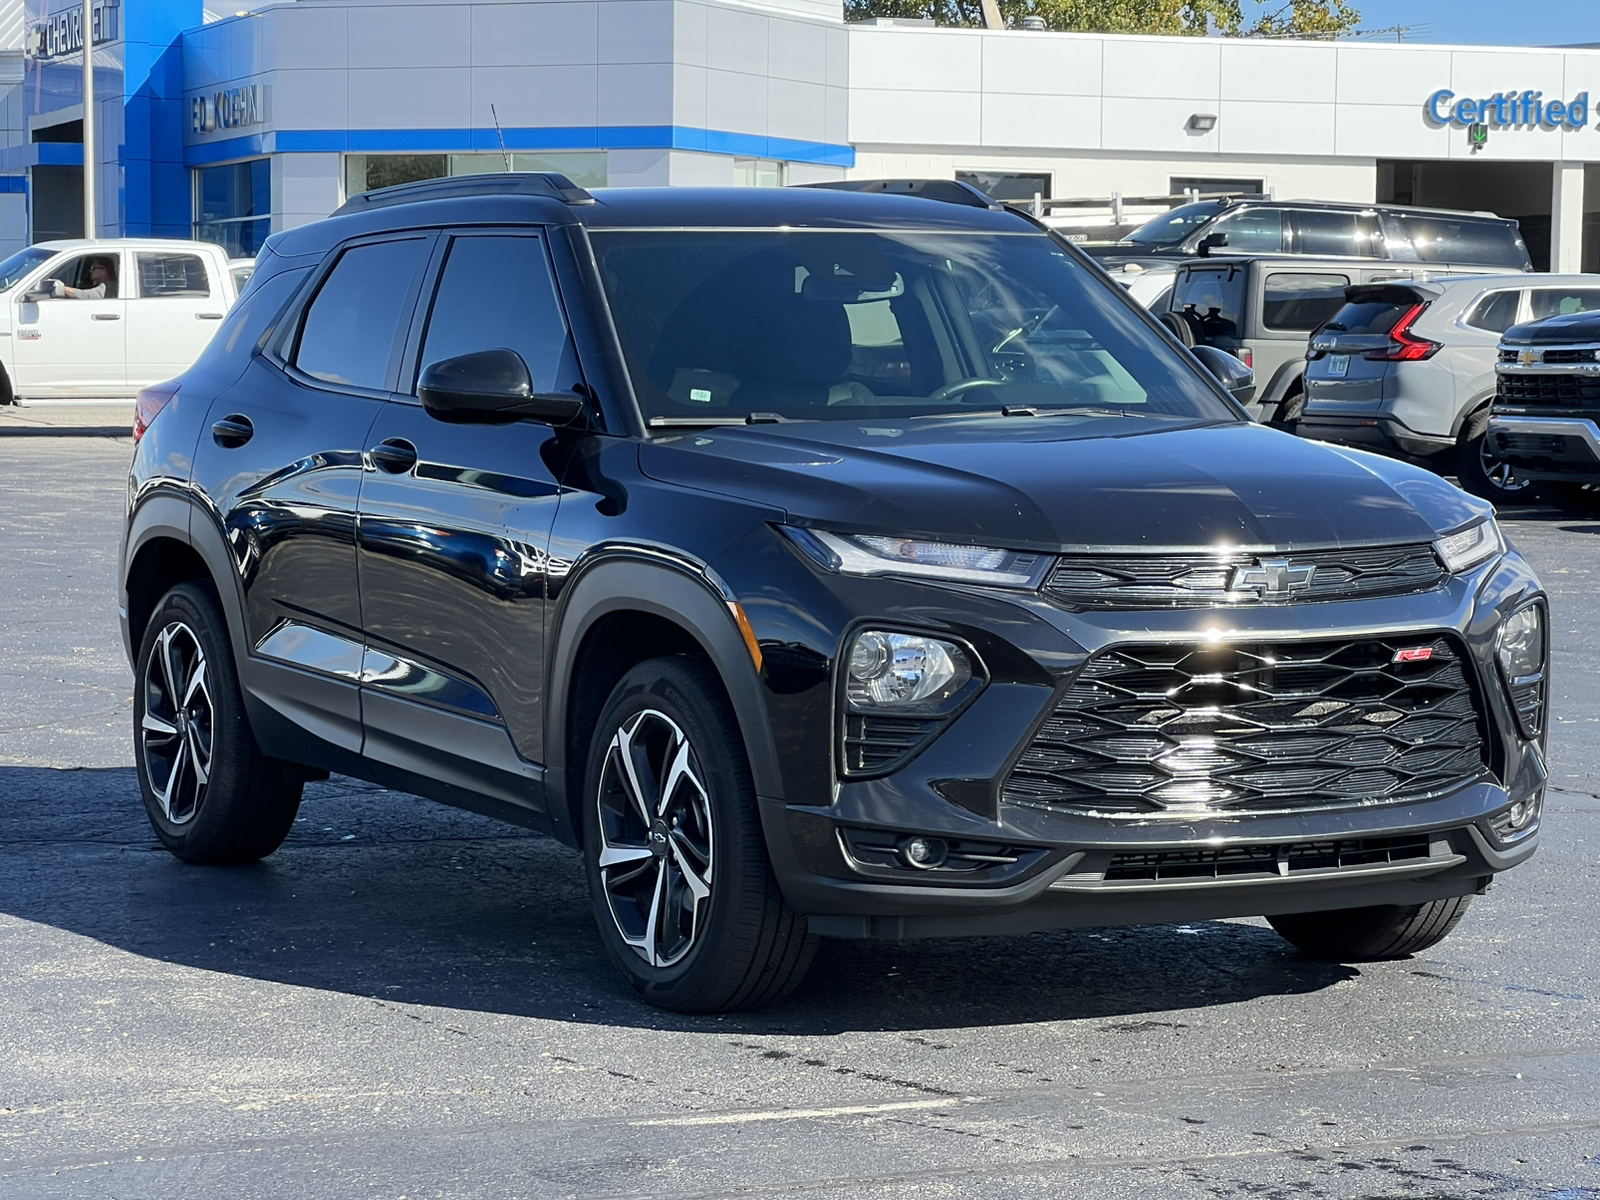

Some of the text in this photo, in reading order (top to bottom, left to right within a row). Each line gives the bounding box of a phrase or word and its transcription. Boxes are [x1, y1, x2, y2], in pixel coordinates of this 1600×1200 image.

[191, 85, 264, 134] ED KOEHN
[1427, 89, 1589, 127] Certified
[1395, 647, 1433, 662] RS
